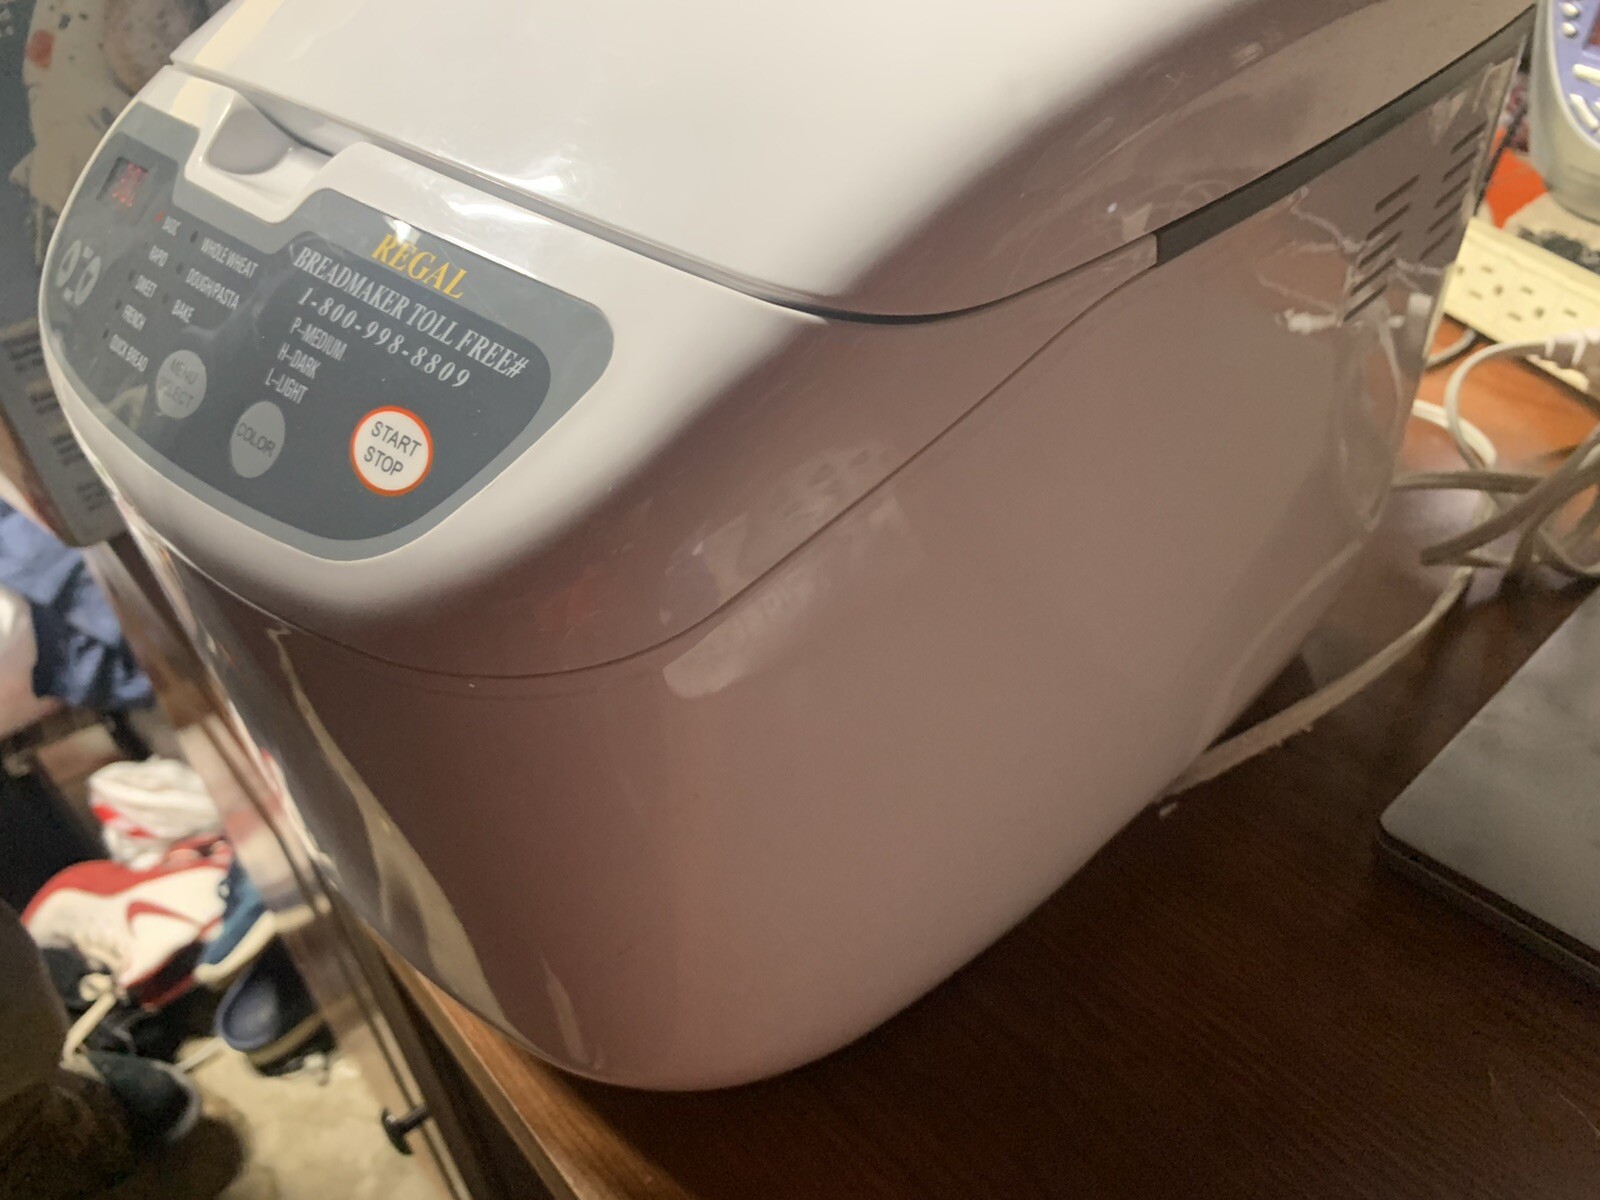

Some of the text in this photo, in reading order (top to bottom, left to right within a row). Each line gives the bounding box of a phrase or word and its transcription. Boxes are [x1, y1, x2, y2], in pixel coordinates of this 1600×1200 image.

[200, 237, 258, 278] WHOLE WHEAT
[370, 234, 469, 299] REGAL
[171, 299, 196, 323] BAKE
[293, 247, 530, 379] BREADMAKER TOLL FREE#
[289, 317, 348, 361] P-MEDIUM
[298, 286, 471, 388] 1-800-998-8809
[277, 343, 322, 379] H-DARK
[264, 368, 308, 403] L-LIGHT
[236, 422, 276, 458] COLOR
[371, 420, 422, 457] START
[363, 445, 404, 476] STOP
